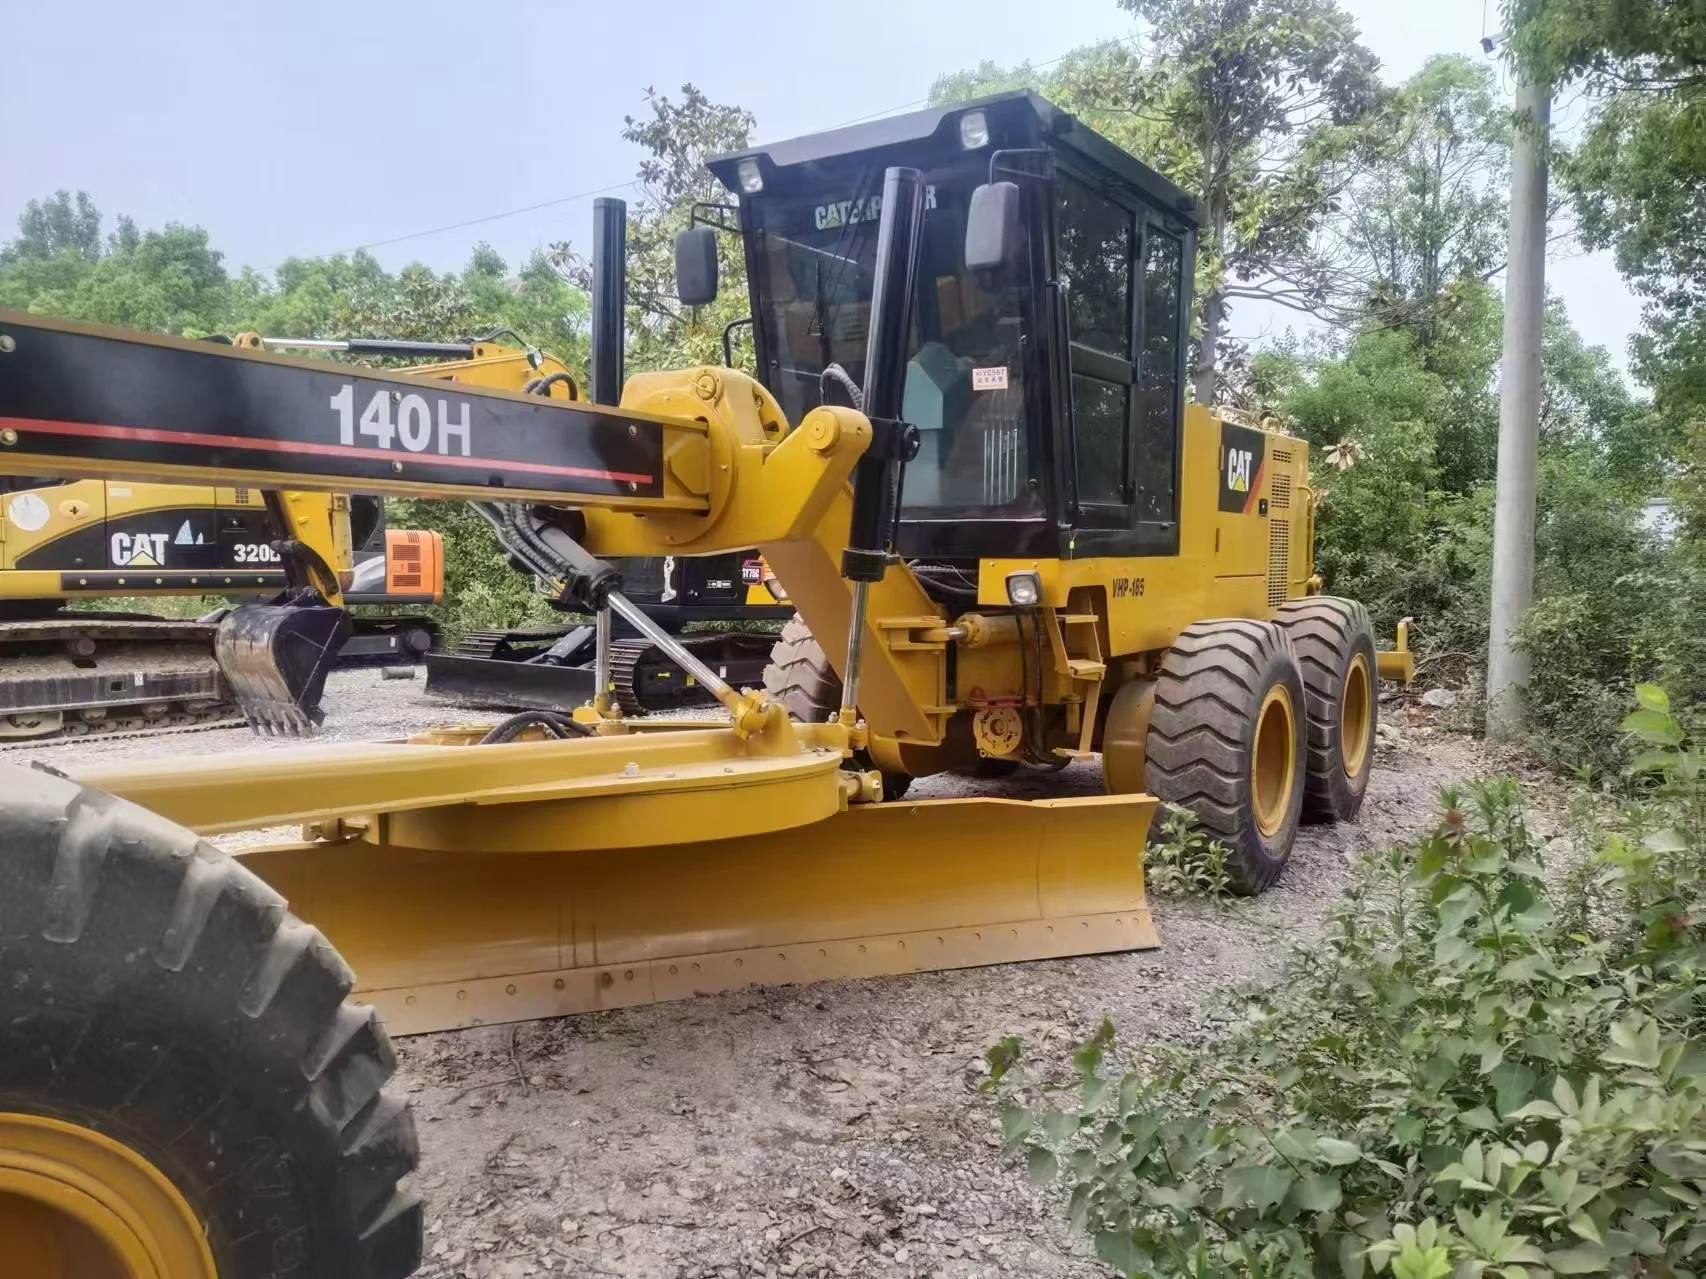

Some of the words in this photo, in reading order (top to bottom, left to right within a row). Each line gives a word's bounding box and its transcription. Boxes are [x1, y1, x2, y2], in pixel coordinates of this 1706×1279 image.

[814, 184, 938, 231] CATERPR
[329, 384, 472, 457] 140H
[1227, 447, 1253, 493] CAT
[111, 532, 170, 567] CAT
[1112, 577, 1145, 598] VHP-185
